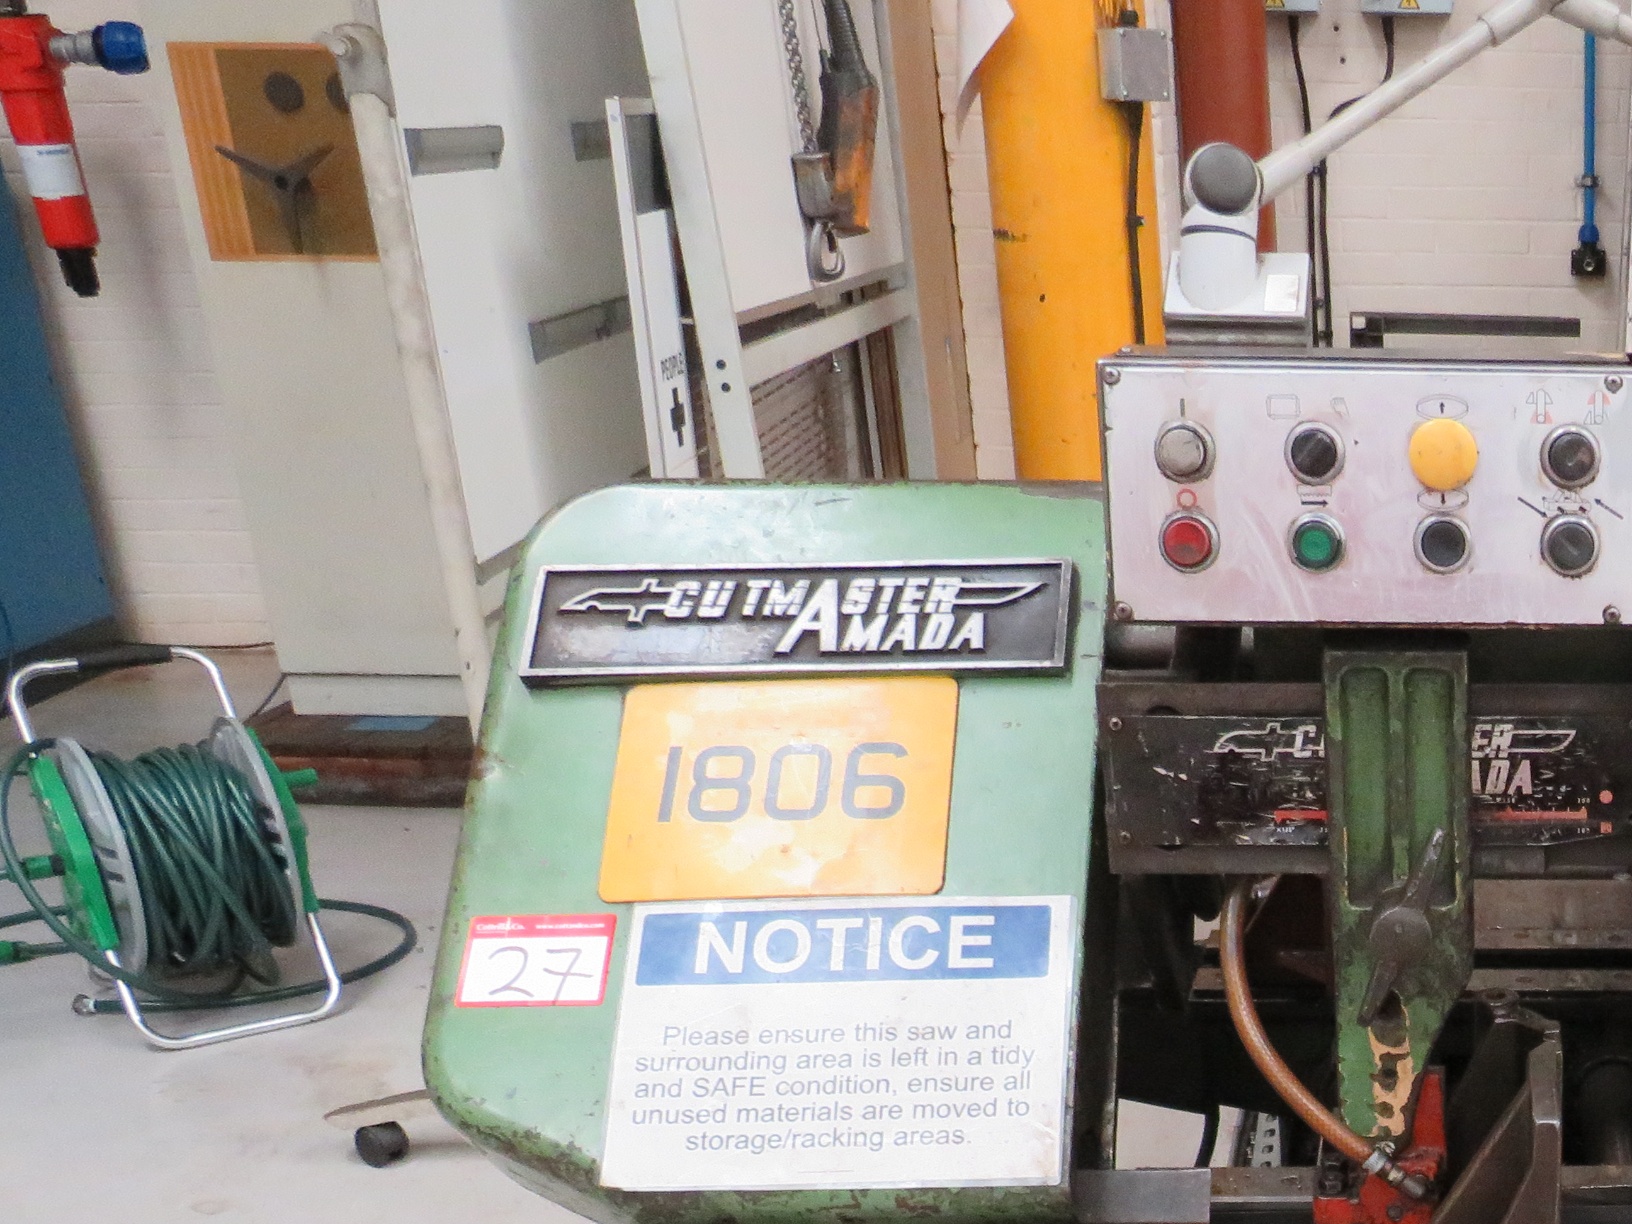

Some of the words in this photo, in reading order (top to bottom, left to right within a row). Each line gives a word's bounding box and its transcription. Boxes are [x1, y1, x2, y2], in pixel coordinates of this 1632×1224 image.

[774, 588, 986, 654] AMADA
[657, 742, 907, 824] 1806
[692, 914, 995, 975] NOTICE
[487, 945, 594, 1005] 27
[663, 1026, 749, 1045] Please
[759, 1028, 845, 1044] ensure
[855, 1022, 898, 1041] this
[907, 1026, 957, 1041] saw
[966, 1020, 1012, 1039] and
[635, 1050, 786, 1075] surrounding
[796, 1053, 852, 1069] area
[863, 1049, 881, 1067] is
[891, 1047, 928, 1067] left
[938, 1047, 958, 1065] in
[967, 1051, 981, 1065] a
[991, 1045, 1034, 1069] tidy
[635, 1078, 682, 1098] and
[692, 1076, 766, 1098] SAFE
[773, 1072, 896, 1096] condition,
[908, 1076, 994, 1092] ensure
[1003, 1071, 1030, 1091] all
[632, 1104, 727, 1124] unused
[737, 1101, 852, 1122] materials
[862, 1105, 903, 1120] are
[913, 1098, 997, 1118] moved
[1008, 1098, 1030, 1116] to
[686, 1127, 883, 1152] storage/racking
[894, 1129, 971, 1146] areas.
